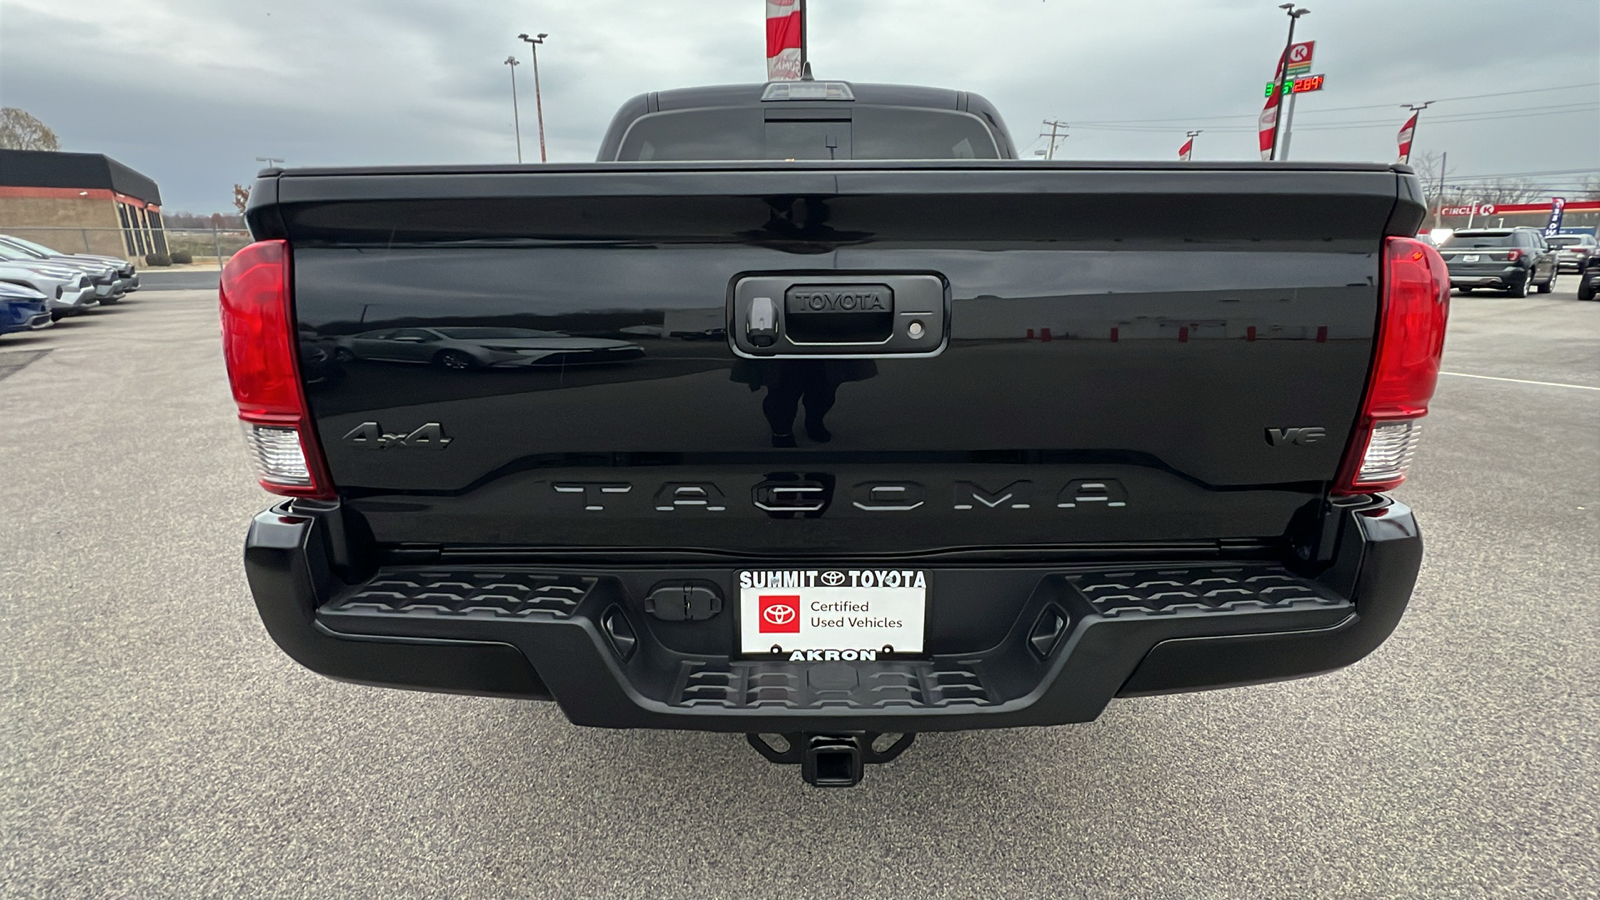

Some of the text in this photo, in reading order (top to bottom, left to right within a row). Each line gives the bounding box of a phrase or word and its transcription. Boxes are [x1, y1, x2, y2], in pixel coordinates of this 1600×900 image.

[1441, 206, 1478, 216] CIRCLE
[795, 292, 886, 312] TOYOTA
[1264, 426, 1326, 447] V6
[551, 480, 1128, 512] TACOMA
[739, 570, 927, 588] SUMMIT TOYOTA
[810, 600, 869, 612] Certified
[811, 617, 903, 629] Used Vehicles
[789, 650, 877, 662] AKRON
